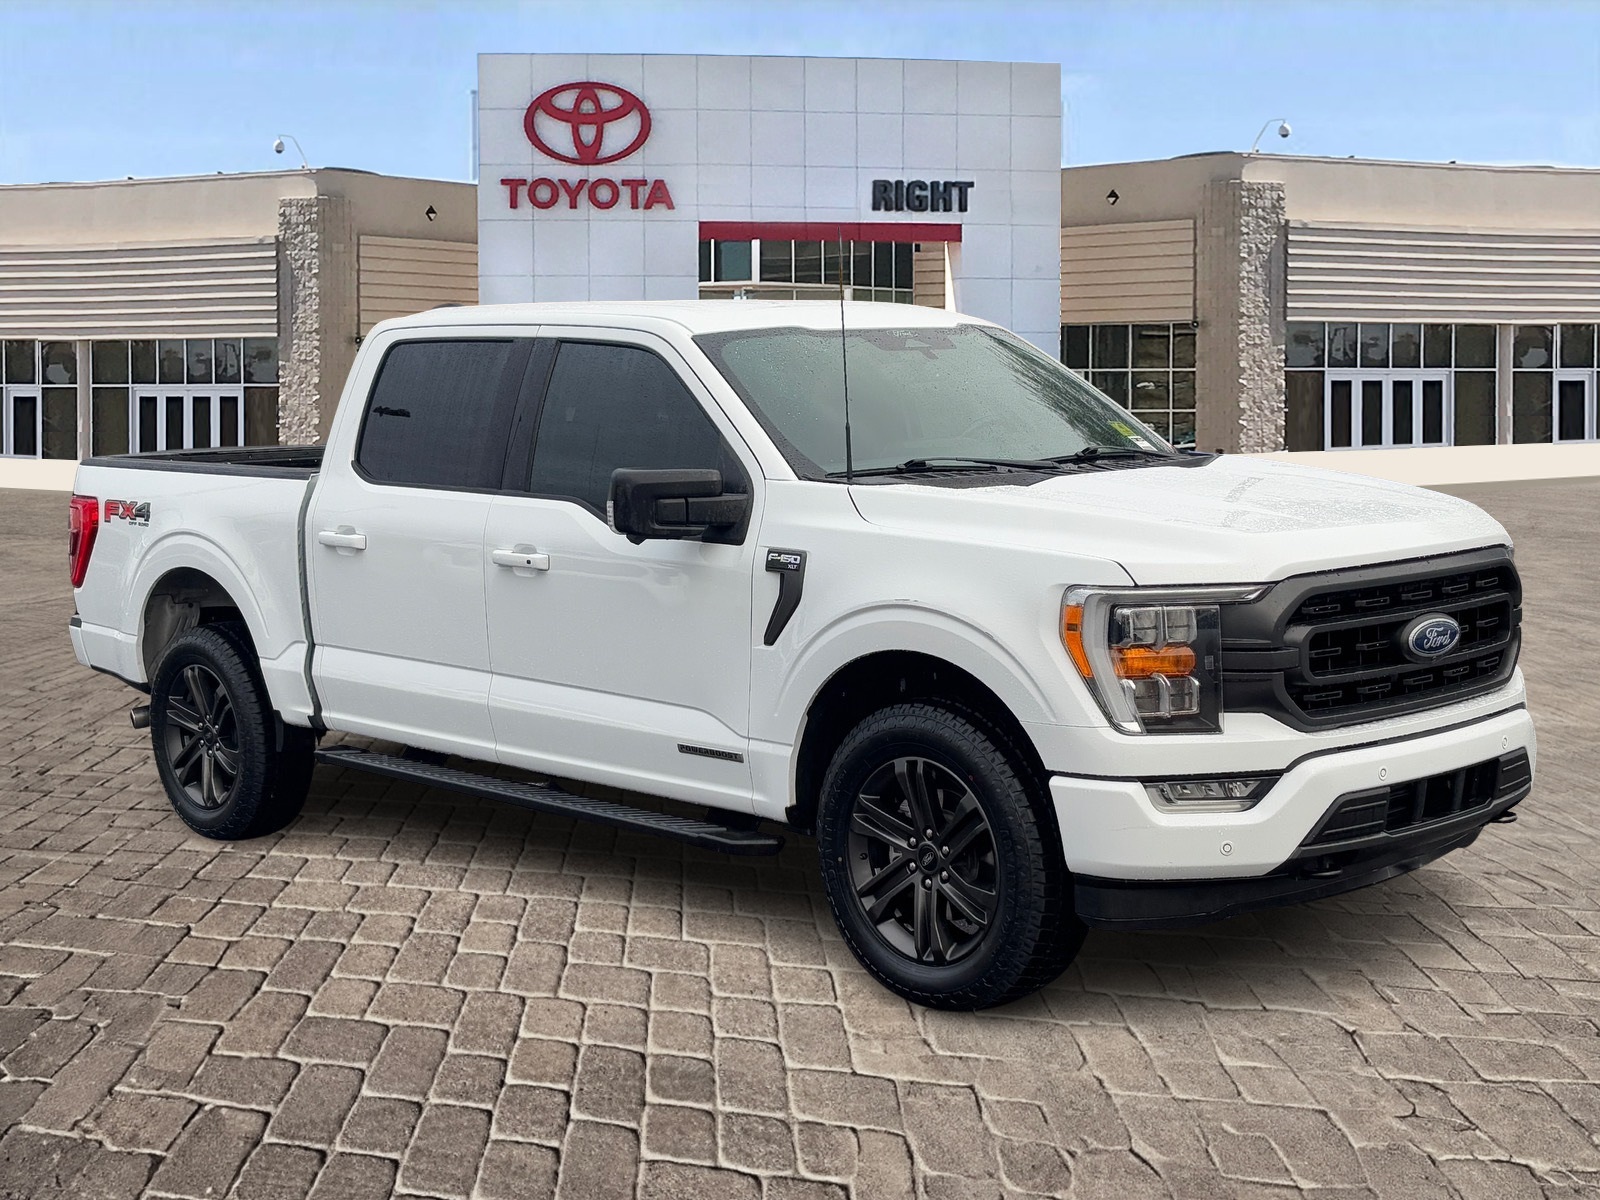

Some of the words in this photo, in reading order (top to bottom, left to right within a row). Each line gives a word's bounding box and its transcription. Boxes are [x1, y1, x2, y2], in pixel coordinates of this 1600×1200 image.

[500, 178, 675, 210] TOYOTA
[872, 180, 975, 213] RIGHT
[104, 499, 151, 523] FX4
[768, 553, 801, 564] F-150
[1423, 626, 1451, 649] Ford
[679, 744, 739, 760] POWERBOOST
